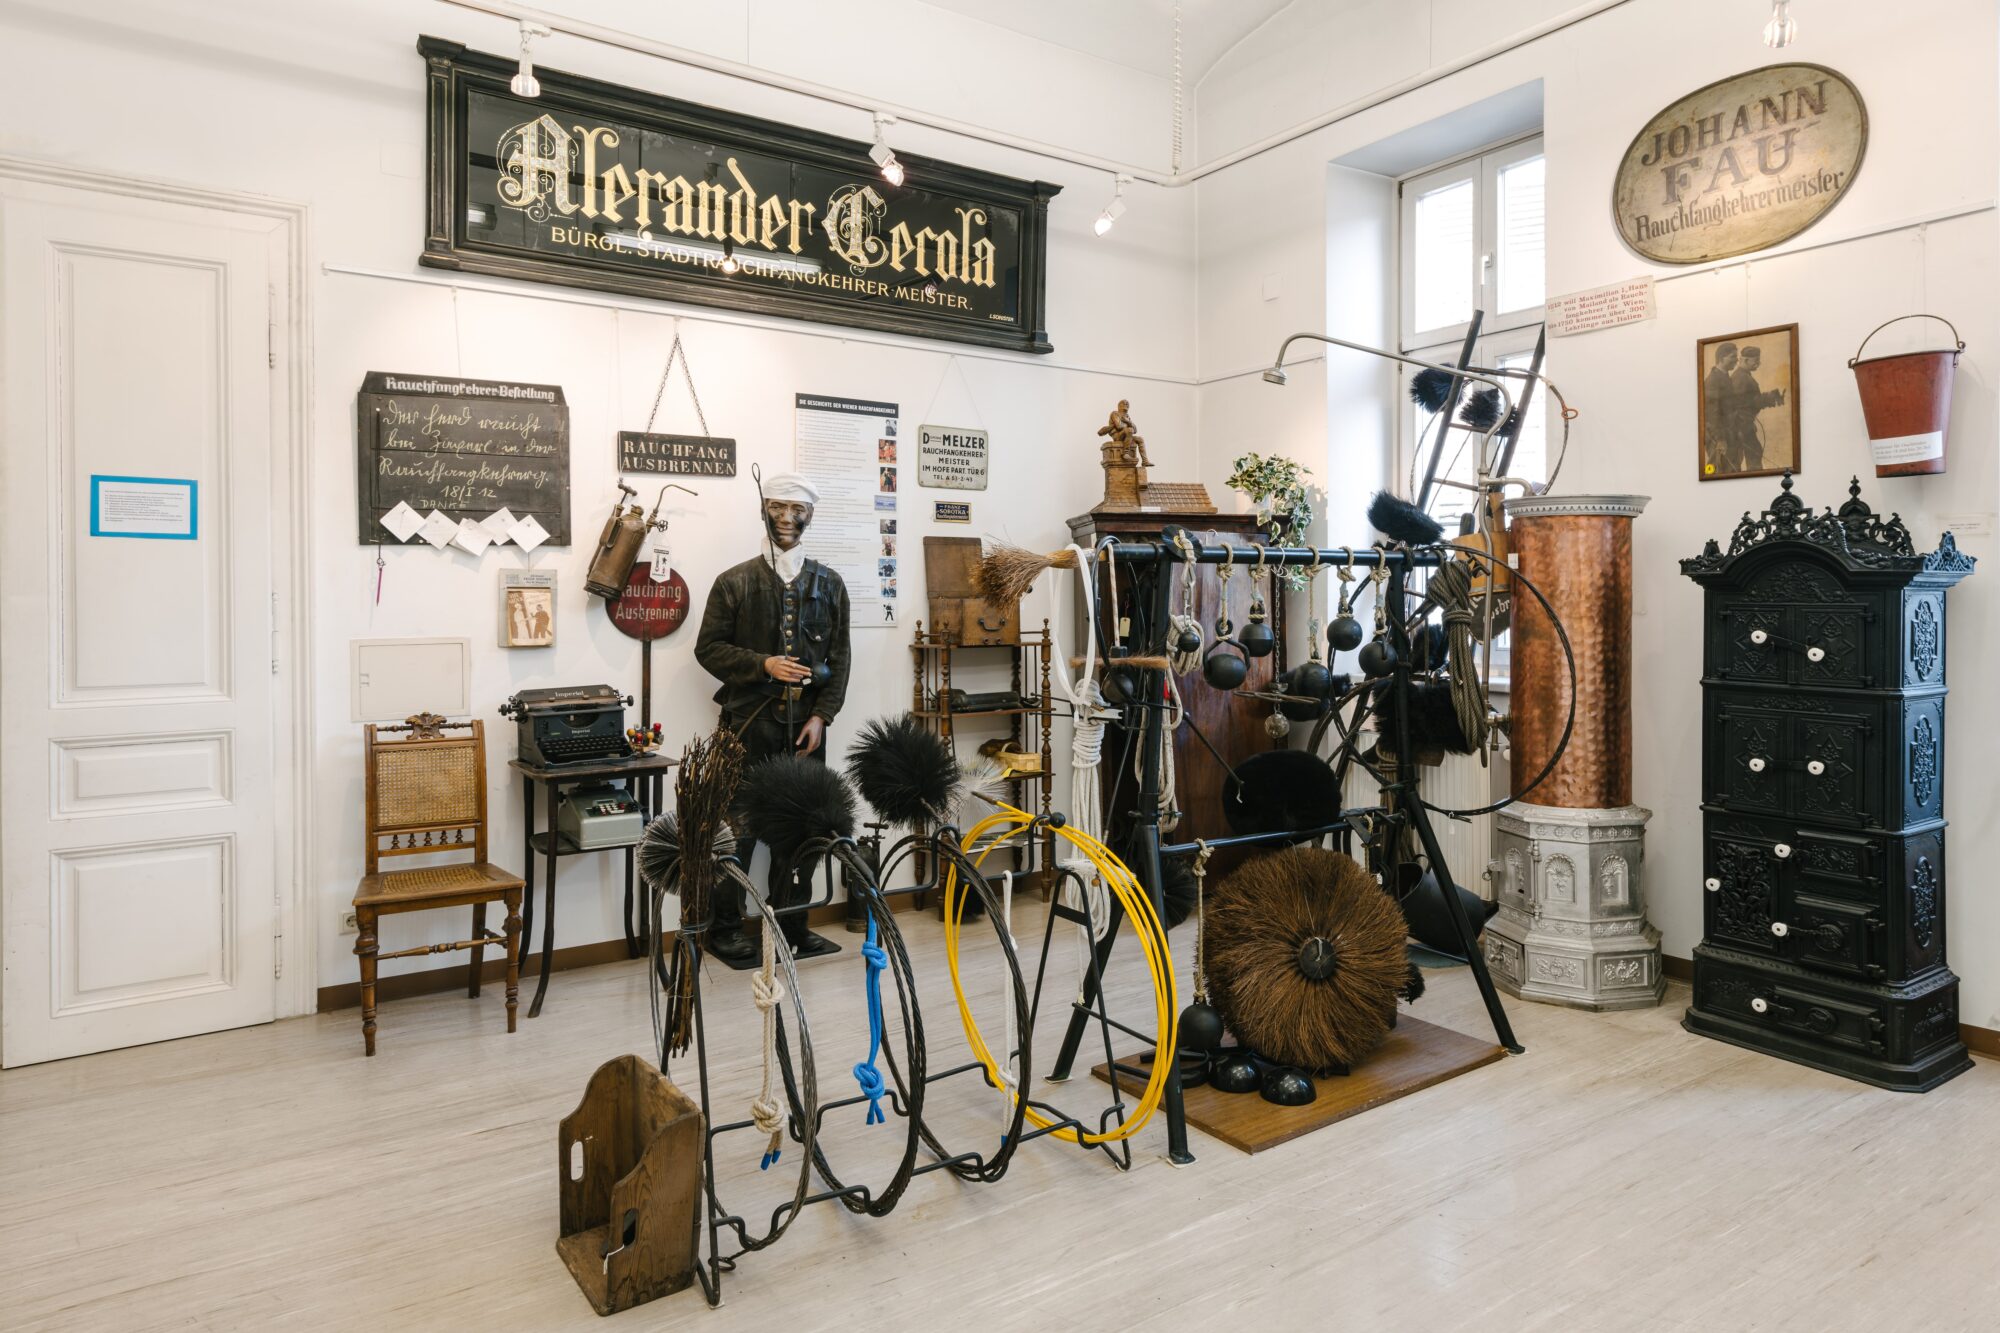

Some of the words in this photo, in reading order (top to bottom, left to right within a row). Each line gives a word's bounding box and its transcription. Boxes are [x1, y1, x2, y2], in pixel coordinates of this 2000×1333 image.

[1641, 79, 1829, 166] JOHANN
[1660, 127, 1799, 206] FAU
[1635, 167, 1844, 242] Rauchfangkehrermeister
[551, 226, 632, 254] BÜRGL.
[1579, 290, 1618, 303] Maximilian
[1628, 283, 1648, 291] Hans
[1579, 298, 1607, 309] Mailand
[1620, 291, 1647, 300] Rauch-
[1558, 319, 1573, 327] 1750
[1575, 313, 1606, 323] kommen
[1629, 305, 1645, 313] 300
[1565, 307, 1603, 319] fangkehrer
[1565, 321, 1599, 332] Lehrlinge
[1617, 313, 1641, 323] Italien
[807, 400, 832, 408] GESCHICHTE
[624, 440, 728, 460] RAUCHFANG
[942, 434, 985, 449] MELZER
[922, 447, 986, 458] RAUCHFANGKEHRER-
[938, 457, 970, 466] MEISTER
[622, 457, 736, 475] AUSBRENNEN
[932, 466, 950, 474] HOFE
[967, 467, 979, 475] TÜR
[421, 499, 469, 509] DANKE
[621, 578, 682, 602] auchfang
[615, 602, 682, 621] Ausbrennen
[555, 690, 584, 698] Imperial
